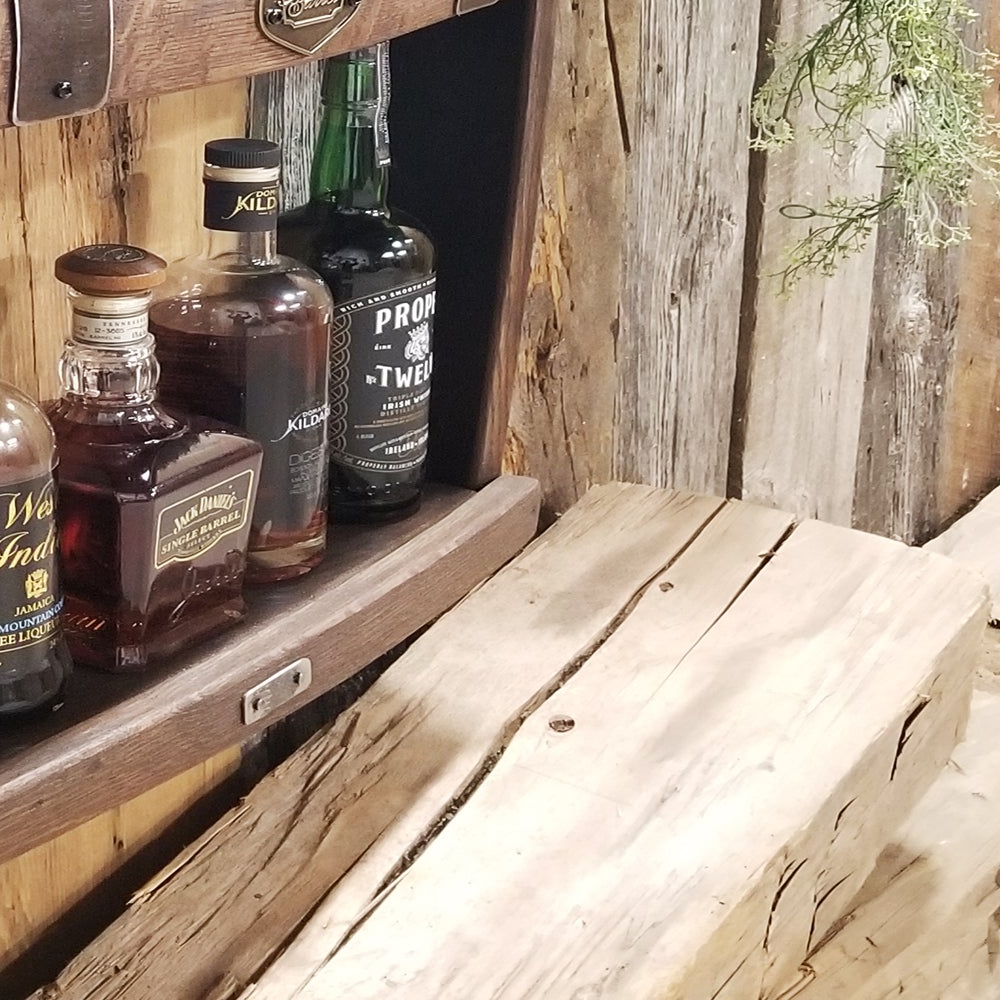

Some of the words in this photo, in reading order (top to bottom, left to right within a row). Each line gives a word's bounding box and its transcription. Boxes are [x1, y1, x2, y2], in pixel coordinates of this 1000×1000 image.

[382, 398, 411, 411] IRISH
[161, 528, 200, 556] SINGLE
[200, 509, 241, 539] BARREL
[173, 502, 200, 535] JACK
